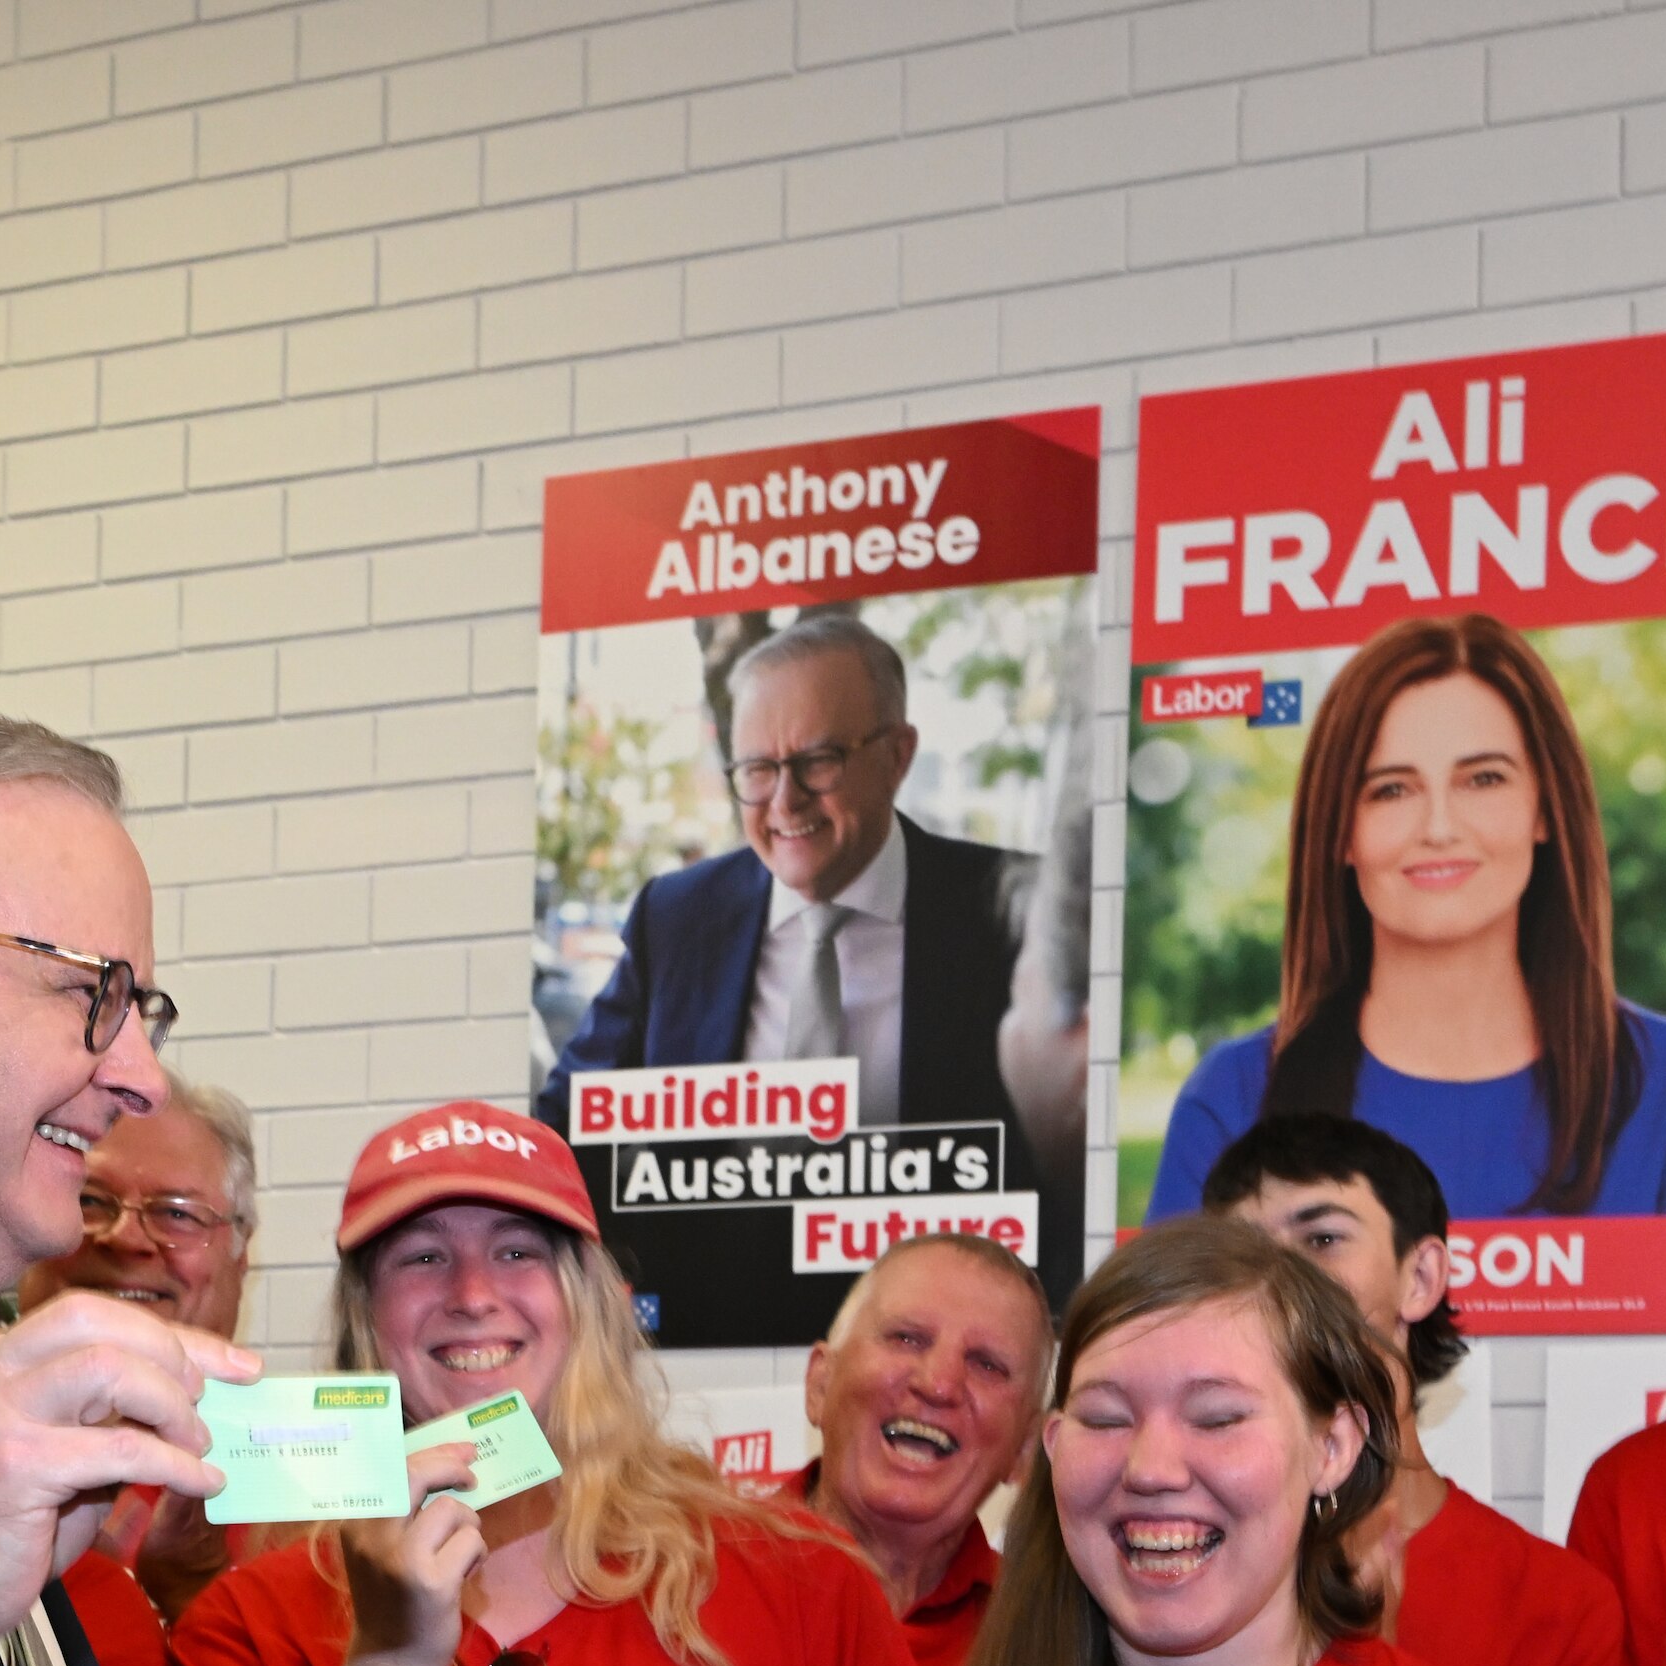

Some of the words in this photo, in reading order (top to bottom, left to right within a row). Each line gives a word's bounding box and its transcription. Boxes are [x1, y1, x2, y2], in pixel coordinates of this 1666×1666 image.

[1371, 377, 1526, 479] Ali
[680, 458, 949, 530] Anthony
[646, 513, 981, 600] Albanese
[1151, 680, 1251, 715] Labor
[389, 1114, 539, 1165] Labor
[580, 1071, 846, 1141] Building
[623, 1133, 988, 1201] Australia's
[319, 1391, 386, 1406] medicare
[720, 1435, 767, 1476] Ali
